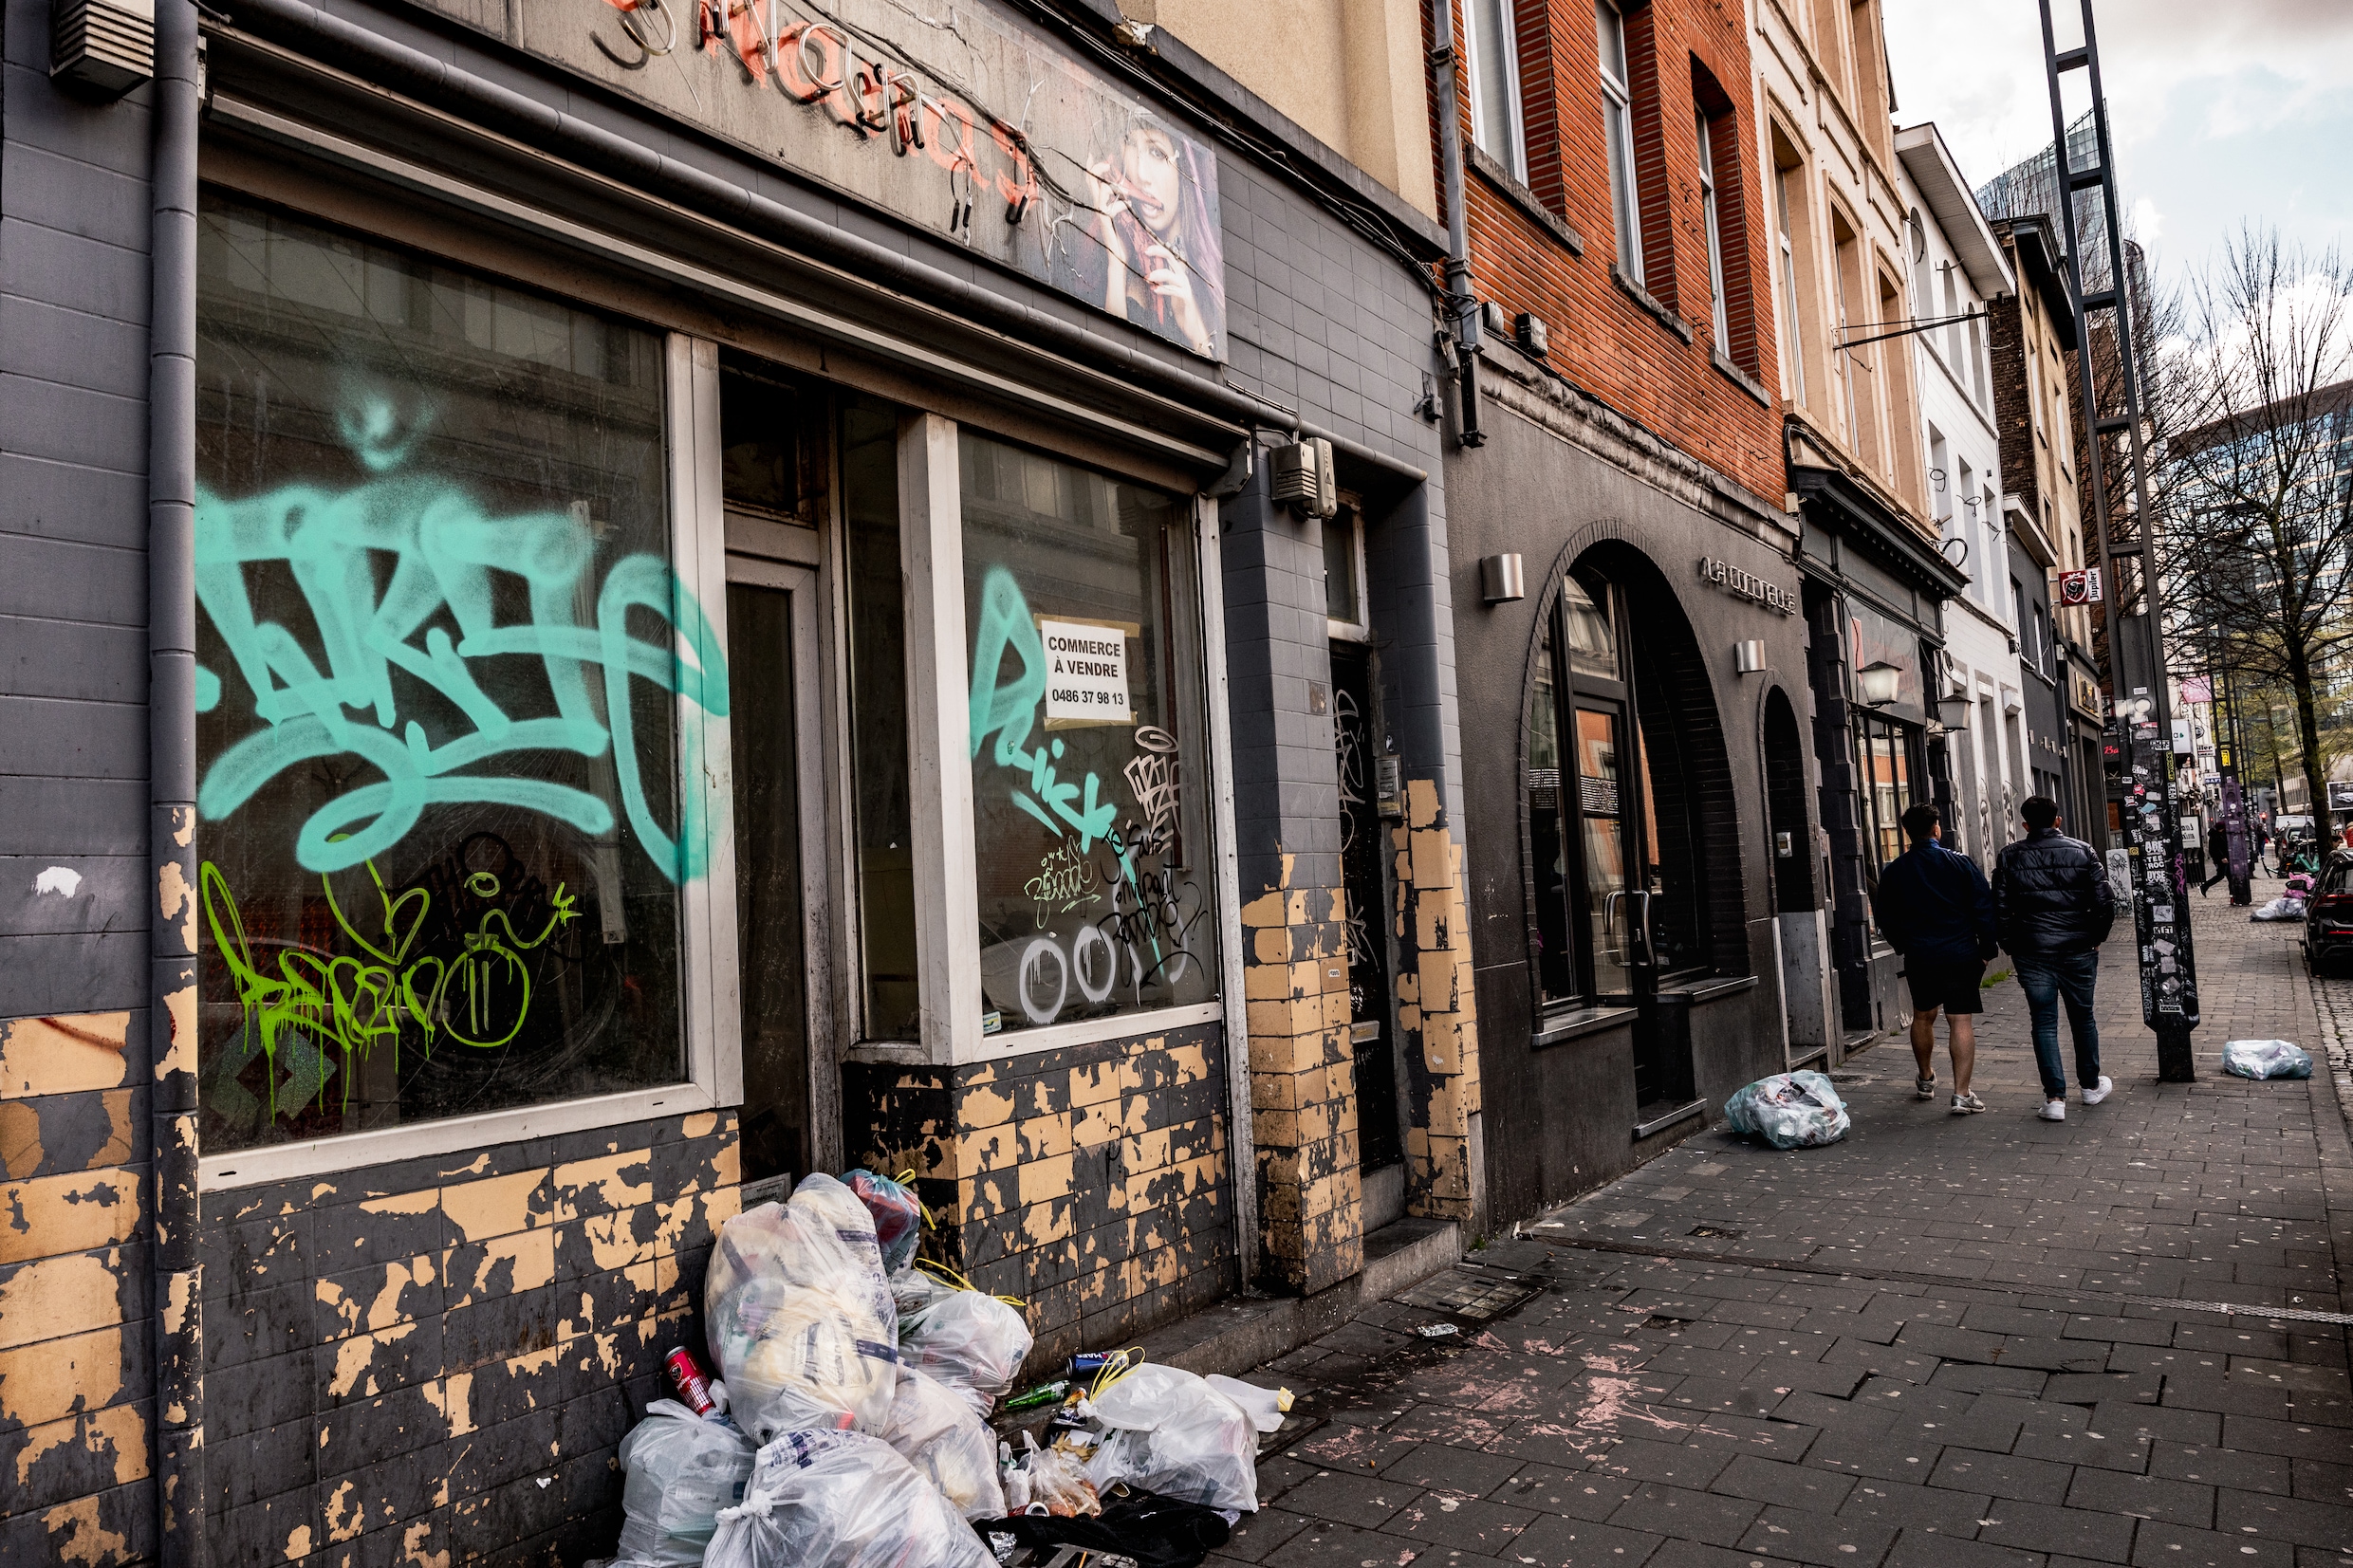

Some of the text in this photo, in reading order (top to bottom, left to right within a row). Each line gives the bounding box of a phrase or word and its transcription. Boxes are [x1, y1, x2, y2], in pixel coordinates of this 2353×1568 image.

[2089, 570, 2099, 600] Jupiler
[1048, 636, 1121, 657] COMMERCE
[1054, 655, 1119, 677] À VENDRE
[1052, 689, 1124, 706] 0486 37 98 13
[2104, 746, 2119, 754] Ba
